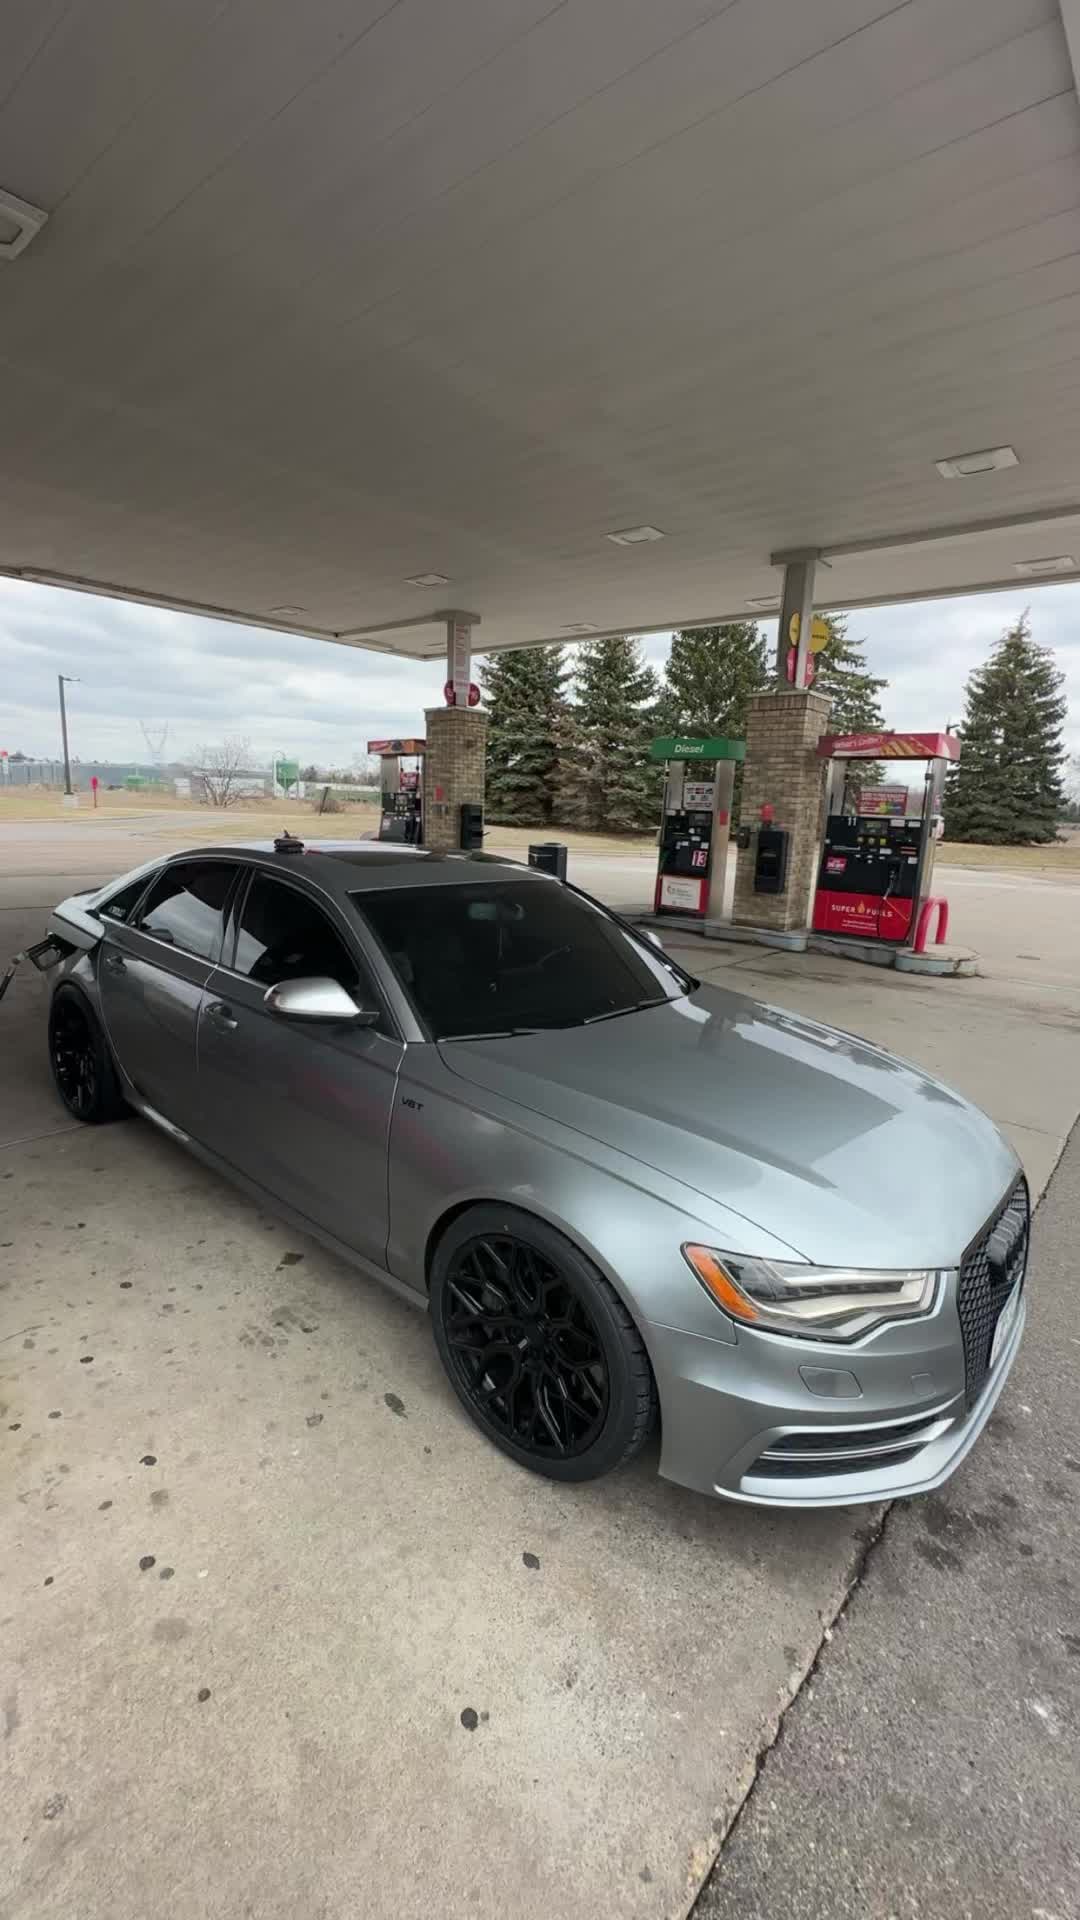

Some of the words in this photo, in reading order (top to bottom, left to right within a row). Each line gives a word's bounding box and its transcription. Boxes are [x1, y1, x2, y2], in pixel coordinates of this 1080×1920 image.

[674, 743, 704, 753] Diesel
[693, 850, 707, 866] 13
[831, 904, 856, 913] SUPER
